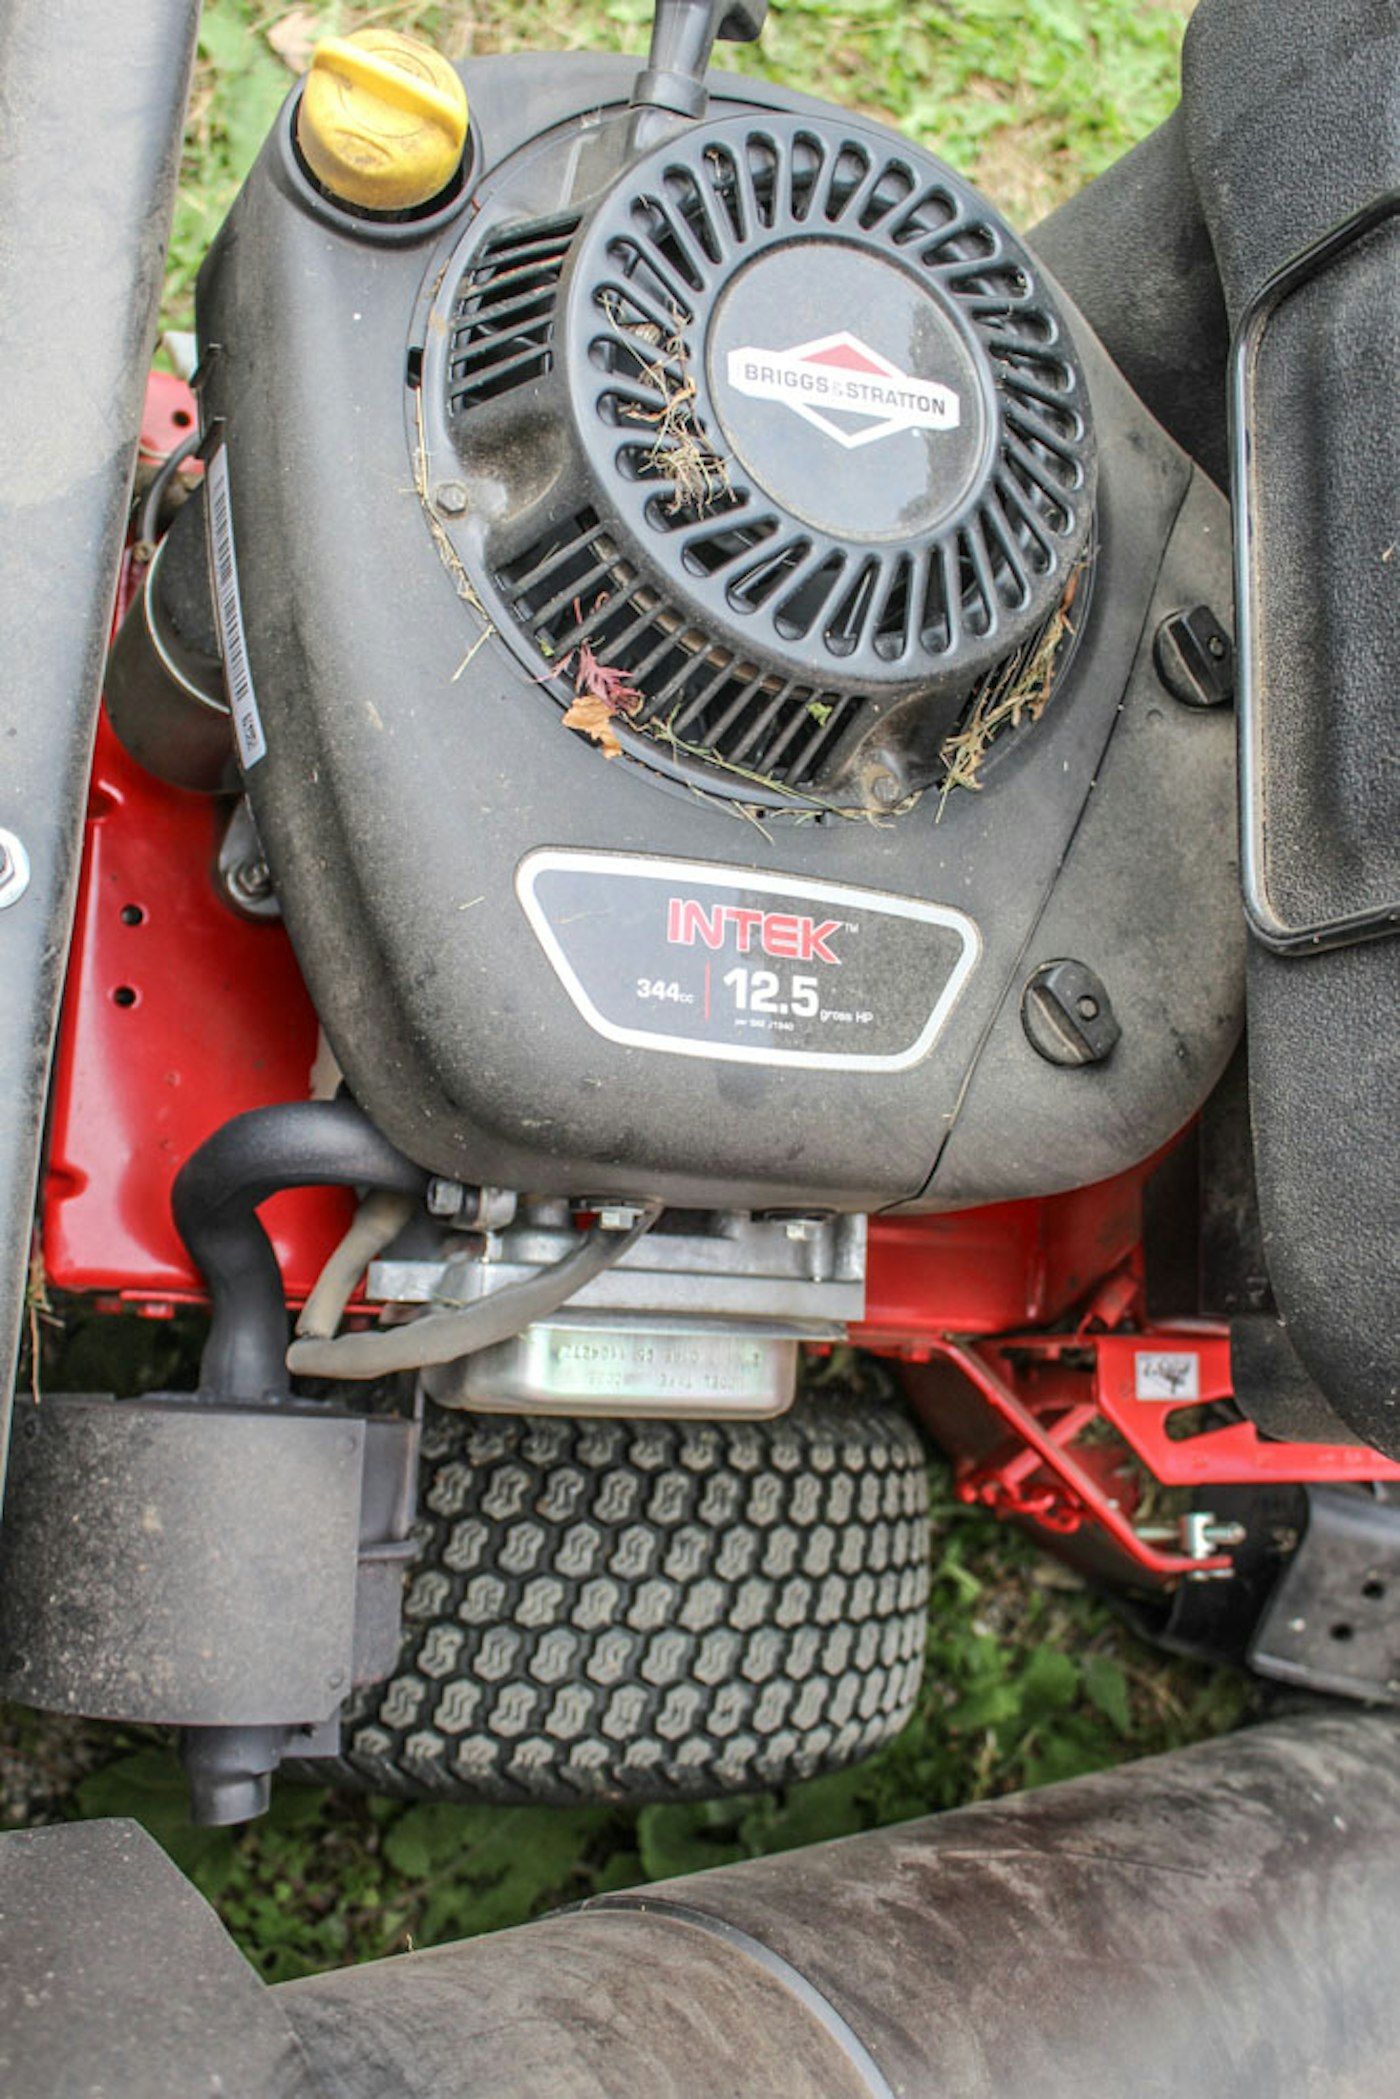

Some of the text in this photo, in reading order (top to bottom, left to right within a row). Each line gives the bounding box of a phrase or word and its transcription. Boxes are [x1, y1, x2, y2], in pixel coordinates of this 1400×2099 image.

[744, 363, 828, 394] BRIGGS
[846, 381, 946, 417] STRATTON
[667, 898, 842, 964] INTEK
[723, 967, 874, 1024] 12.5 gross HP
